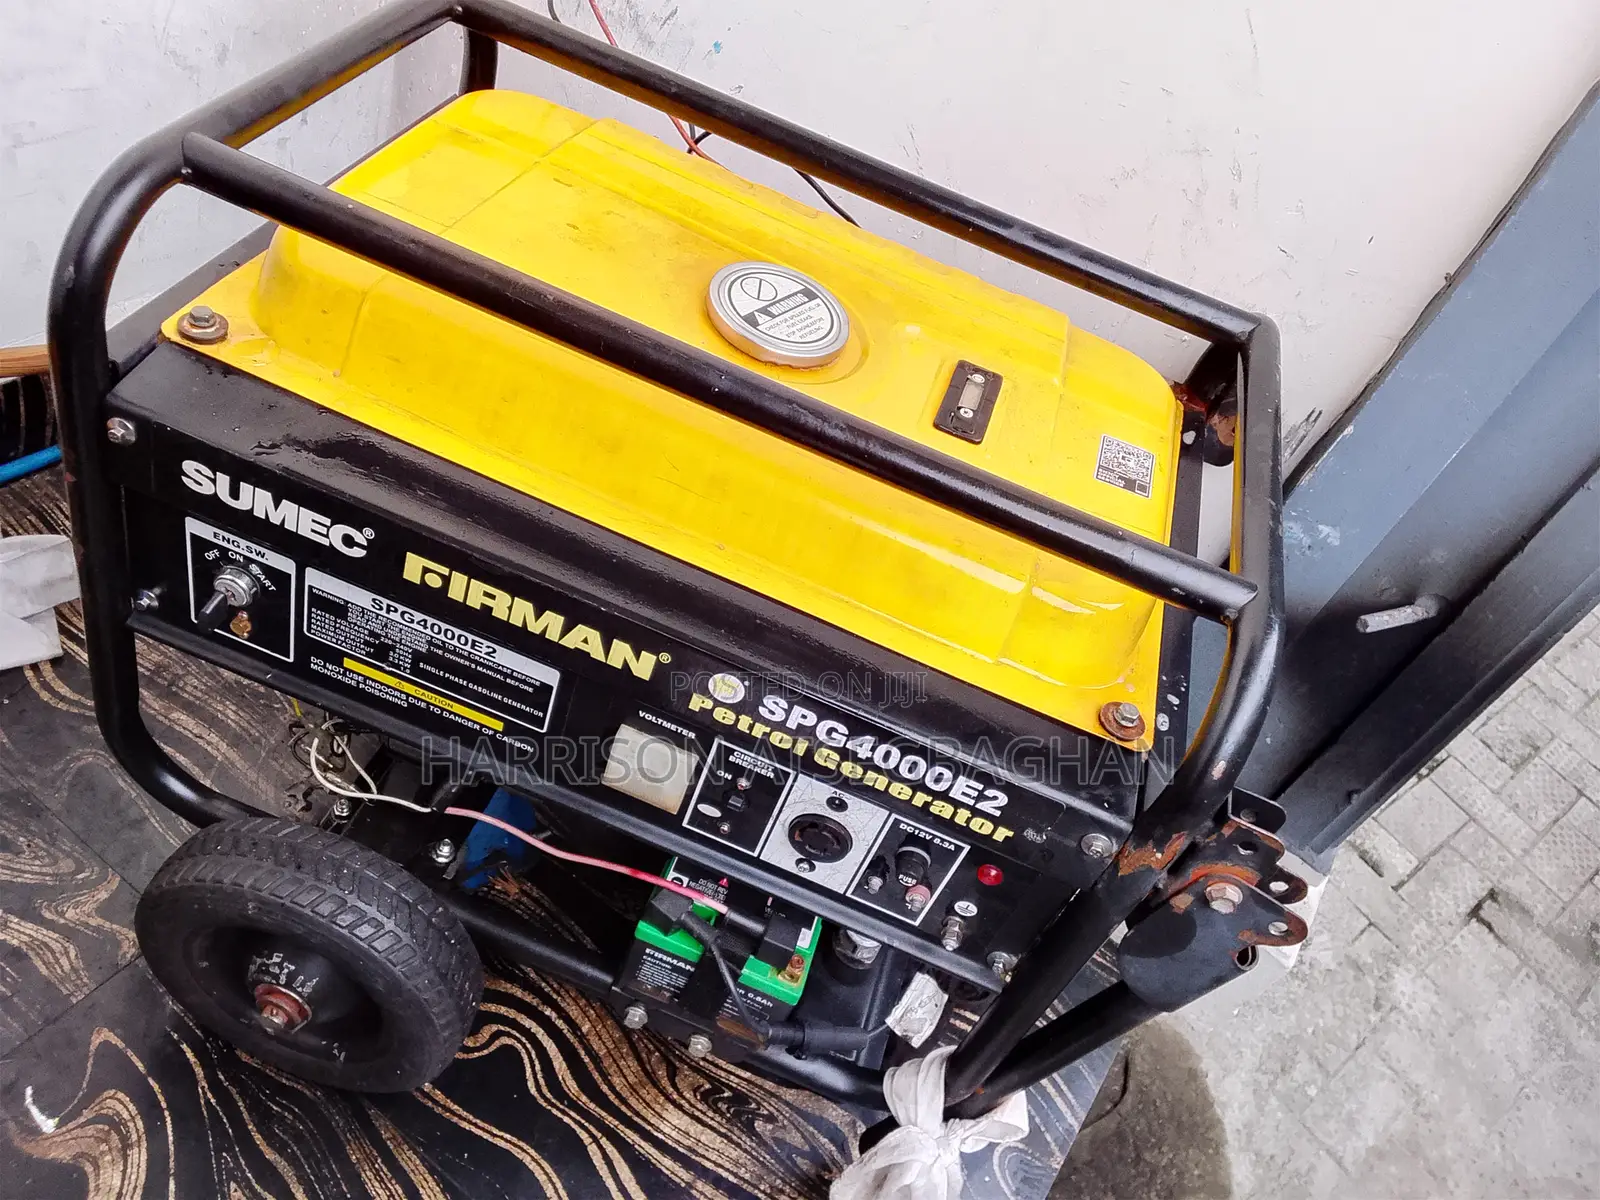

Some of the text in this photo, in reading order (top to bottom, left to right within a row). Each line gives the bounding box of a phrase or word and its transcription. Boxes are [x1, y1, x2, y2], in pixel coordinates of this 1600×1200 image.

[766, 293, 810, 316] WARNING
[181, 460, 369, 558] SUMEC
[204, 549, 244, 563] OFF ON
[213, 531, 269, 561] ENG.SW.
[248, 563, 276, 591] START
[311, 607, 335, 621] RATED
[336, 618, 369, 635] VOLTAGE
[311, 613, 335, 626] RATED
[336, 624, 380, 645] FREQUENCY
[347, 617, 386, 636] OPERATING
[388, 633, 400, 642] THE
[348, 608, 362, 617] YOU
[387, 624, 400, 633] THE
[370, 597, 498, 659] SPG4000E2
[403, 551, 657, 681] FIRMAN
[310, 629, 336, 643] POWER
[337, 641, 366, 655] FACTOR
[311, 618, 335, 631] RATED
[335, 629, 365, 644] OUTPUT
[311, 623, 344, 641] MAXIMUM
[346, 638, 374, 653] OUTPUT
[347, 603, 362, 612] ADD
[363, 608, 377, 618] THE
[378, 615, 431, 641] RECOMMENDED
[432, 638, 443, 646] OIL
[445, 643, 454, 651] TO
[455, 647, 469, 656] THE
[470, 653, 512, 675] CRANKCASE
[513, 671, 541, 687] BEFORE
[347, 613, 534, 693] READ AND UNDERSTAND THE OWNER'S MANUAL BEFORE
[310, 663, 408, 708] MONOXIDE POISONING
[414, 688, 454, 709] CAUTION
[419, 662, 544, 718] SINGLE PHASE GASOLINE GENERATOR
[310, 656, 534, 753] DO NOT USE INDOORS DUE TO DANGER OF CARBON
[638, 710, 697, 739] VOLTMETER
[688, 692, 1015, 843] Petrol Generator
[728, 755, 775, 779] BREAKER
[733, 751, 775, 772] CIRCUIT
[757, 694, 1009, 817] SPG4000E2
[716, 770, 733, 780] ON
[899, 823, 933, 840] DC12V
